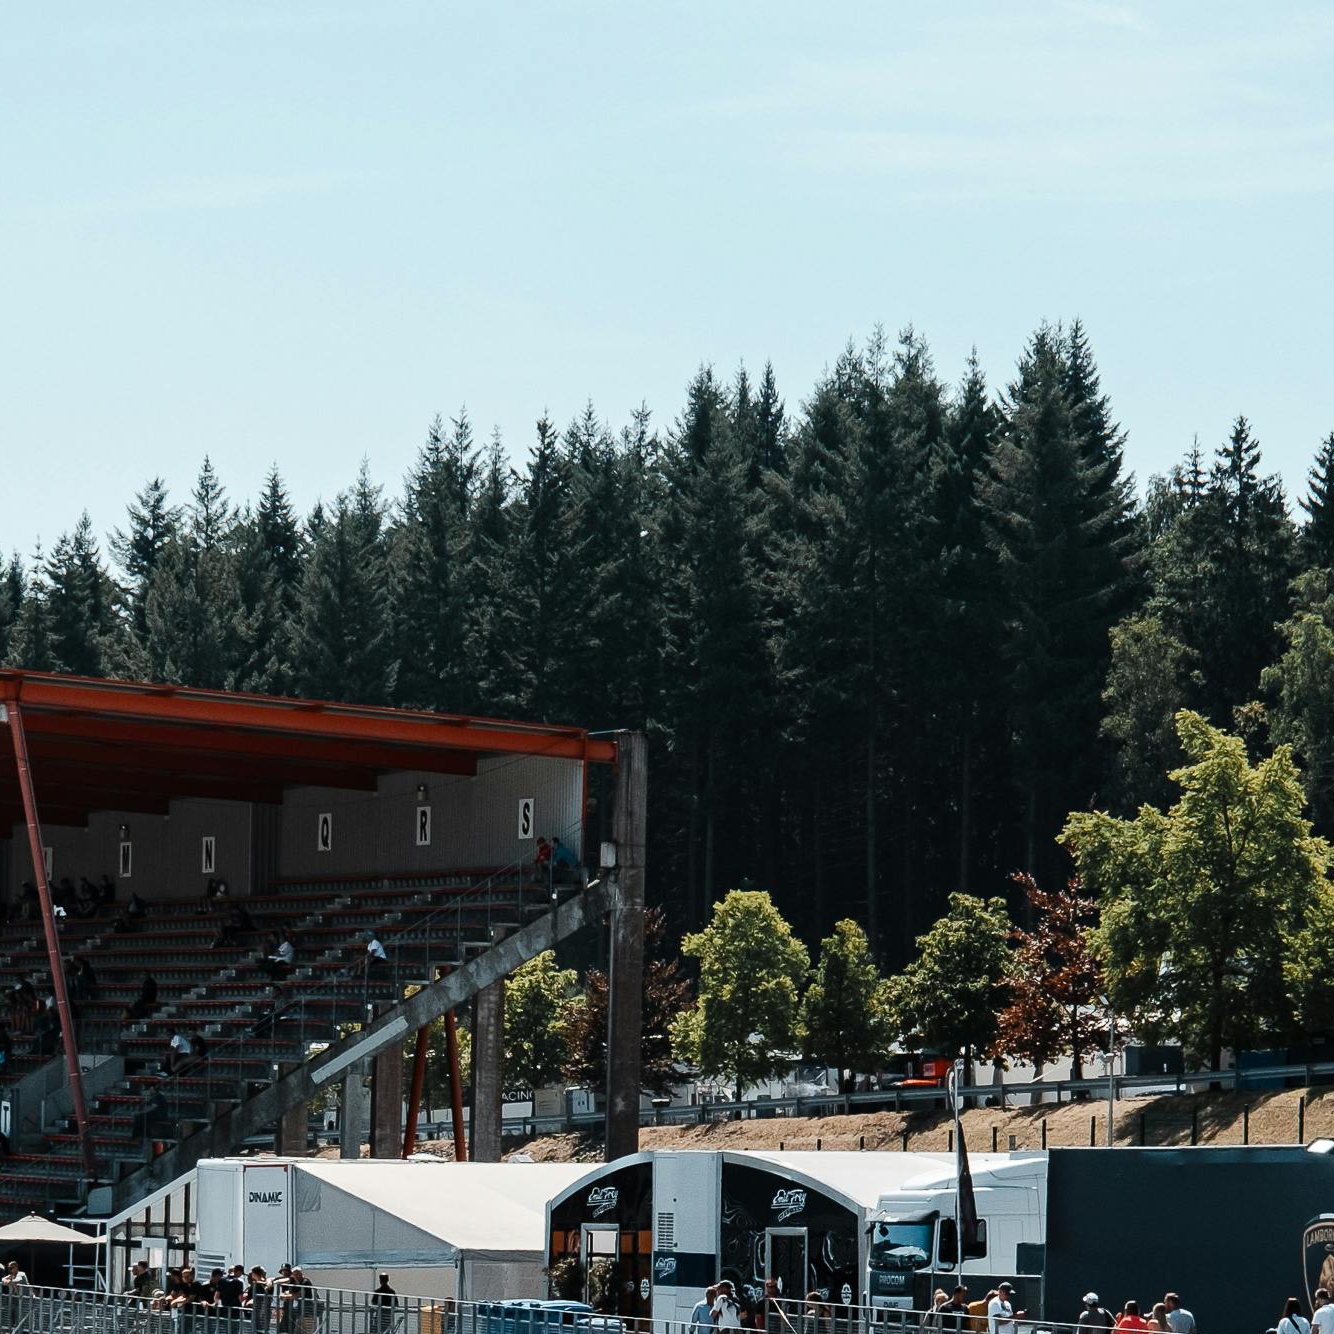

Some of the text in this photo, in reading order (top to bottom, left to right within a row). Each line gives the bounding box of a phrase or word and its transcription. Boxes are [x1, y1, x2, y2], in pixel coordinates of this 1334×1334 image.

[419, 809, 428, 842] R
[521, 801, 531, 836] S
[321, 815, 330, 848] Q
[501, 1090, 534, 1101] ACIN
[248, 1191, 283, 1203] DINAMIC
[879, 1274, 906, 1286] PROCOM
